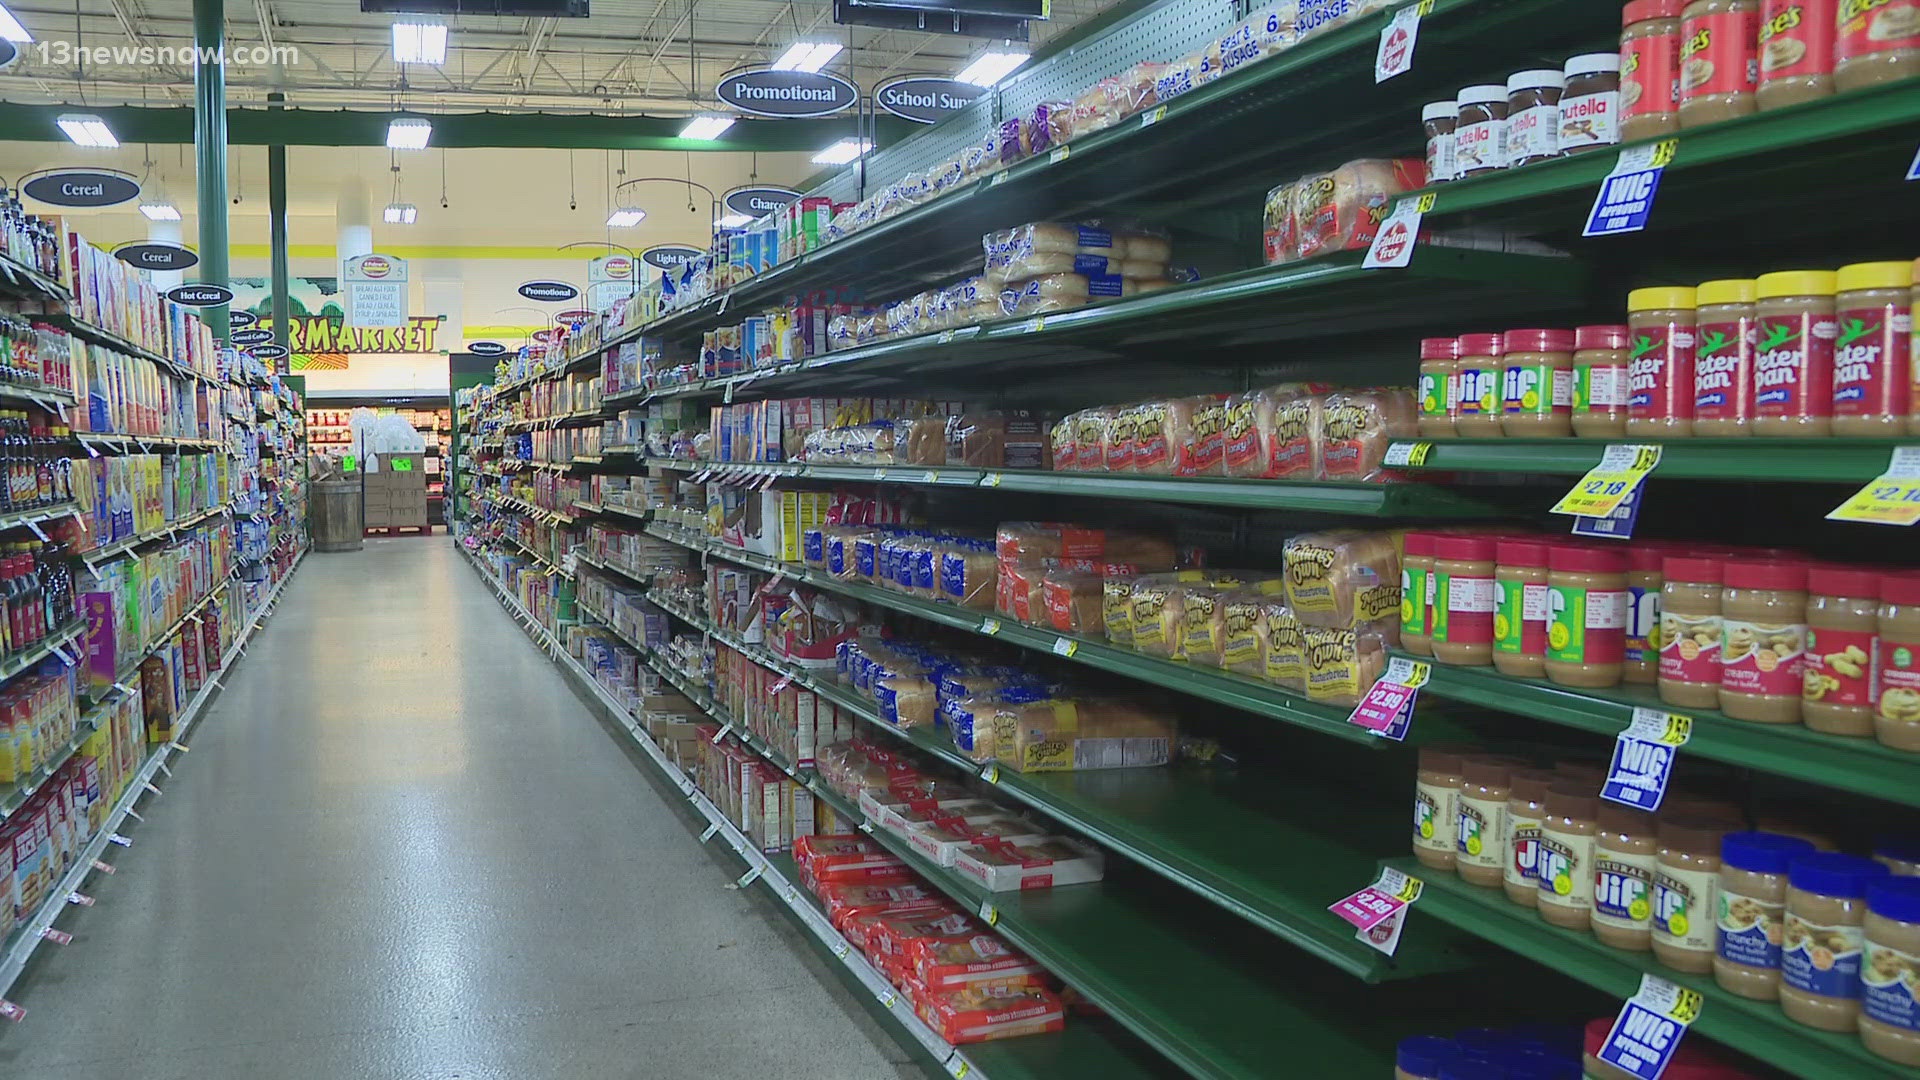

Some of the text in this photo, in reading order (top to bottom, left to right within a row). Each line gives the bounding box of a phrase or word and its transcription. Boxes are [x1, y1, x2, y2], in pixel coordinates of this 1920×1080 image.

[1266, 14, 1278, 32] 6
[1200, 57, 1209, 72] 6
[735, 83, 836, 101] Promotional
[886, 90, 936, 108] School
[1558, 98, 1607, 121] nutella
[62, 183, 103, 197] Cereal
[1606, 171, 1654, 204] WIC
[1598, 200, 1647, 218] APPROVED
[1606, 215, 1629, 229] ITEM
[1376, 231, 1407, 252] Gluten
[142, 252, 172, 263] Cereal
[656, 253, 676, 265] Light
[349, 267, 354, 276] 5
[397, 267, 402, 276] 5
[180, 291, 221, 300] Hot Cereal
[525, 286, 571, 298] Promotional
[472, 344, 502, 352] Promotional
[1584, 480, 1627, 496] $2.18
[1293, 562, 1321, 585] Own
[1313, 645, 1342, 670] Own
[1724, 668, 1760, 682] creamy
[1370, 690, 1404, 709] $2.99
[1620, 740, 1667, 779] WIC
[1595, 873, 1645, 908] Jif
[1726, 932, 1768, 948] crunchy
[1622, 1006, 1675, 1051] WIC
